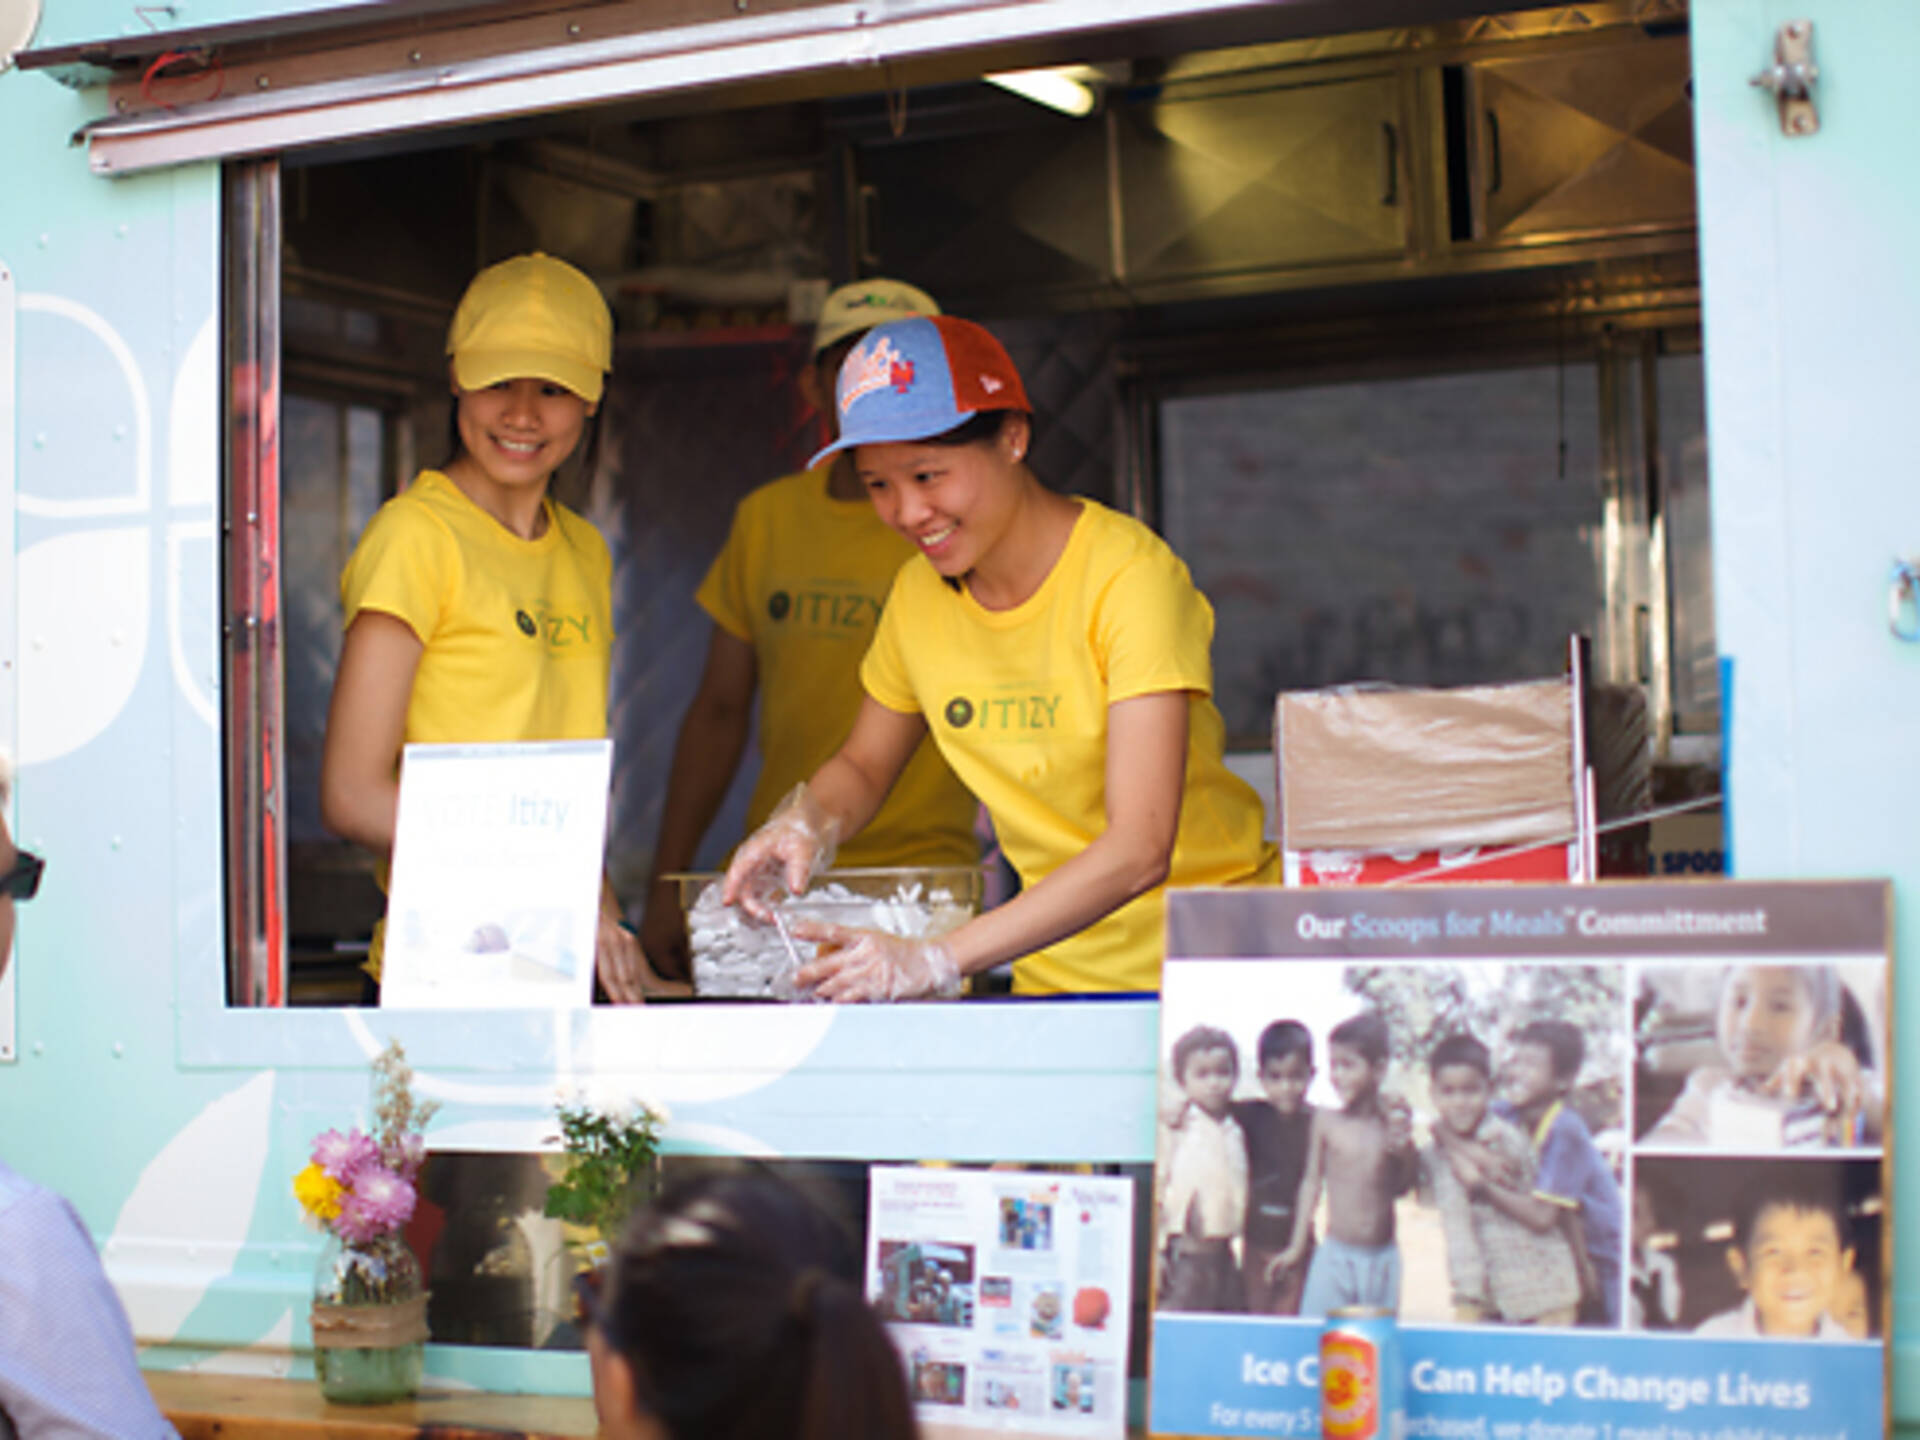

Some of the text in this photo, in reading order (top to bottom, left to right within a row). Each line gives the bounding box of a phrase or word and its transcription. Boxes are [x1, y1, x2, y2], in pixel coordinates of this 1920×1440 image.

[979, 694, 1063, 729] ITIZY
[508, 790, 572, 833] Itizy
[1298, 913, 1345, 939] Our
[1350, 913, 1440, 942] Scoops
[1446, 911, 1481, 936] for
[1242, 1354, 1288, 1386] Ice
[1412, 1360, 1476, 1394] Can
[1485, 1364, 1566, 1405] Help
[1573, 1366, 1710, 1411] Change
[1717, 1373, 1811, 1410] Lives
[1209, 1403, 1240, 1426] For
[1244, 1411, 1295, 1437] every
